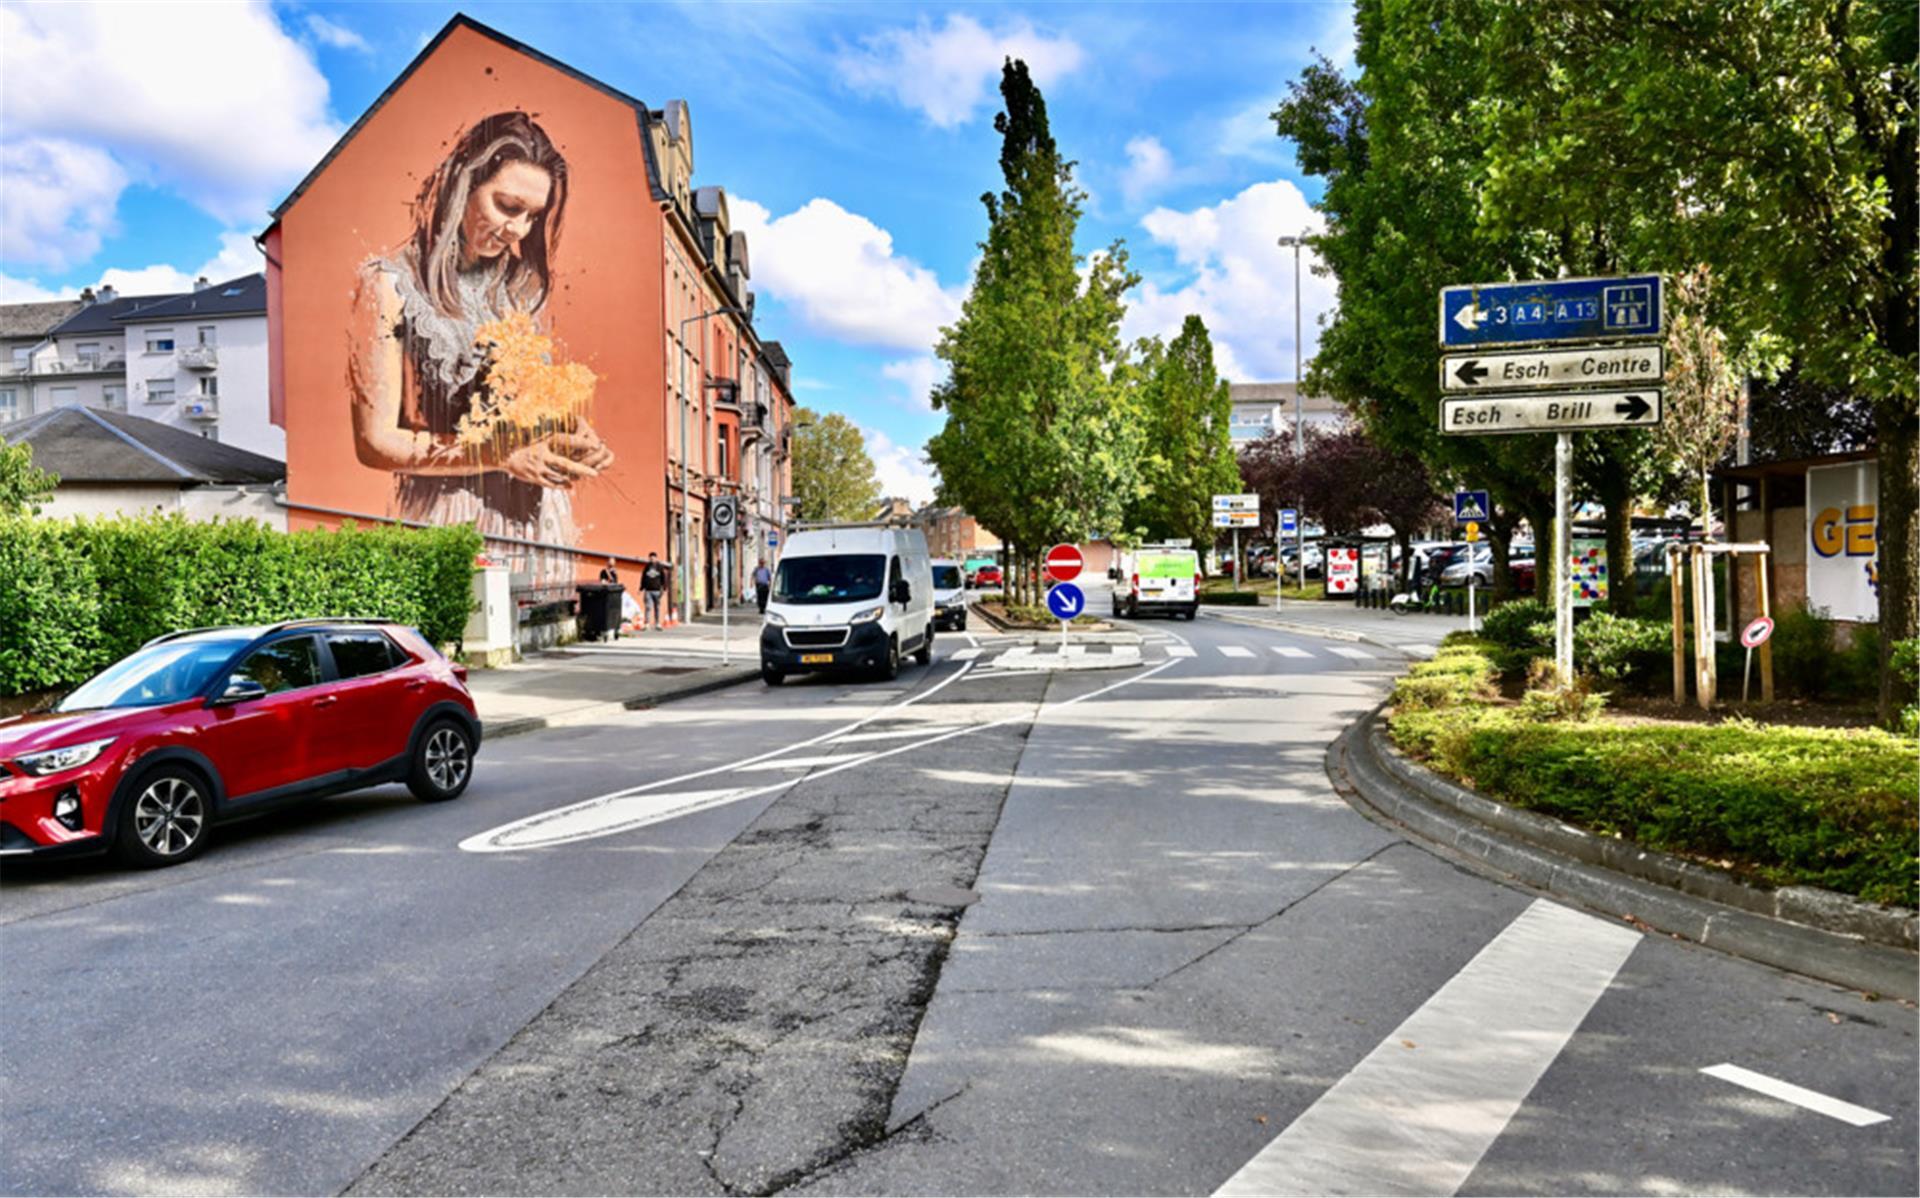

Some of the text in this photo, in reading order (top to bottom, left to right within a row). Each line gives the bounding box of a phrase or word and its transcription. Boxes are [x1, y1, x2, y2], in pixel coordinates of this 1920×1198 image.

[1503, 360, 1550, 380] Esch
[1581, 357, 1652, 376] Centre
[1452, 406, 1501, 425] Esch
[1546, 402, 1592, 420] Brill
